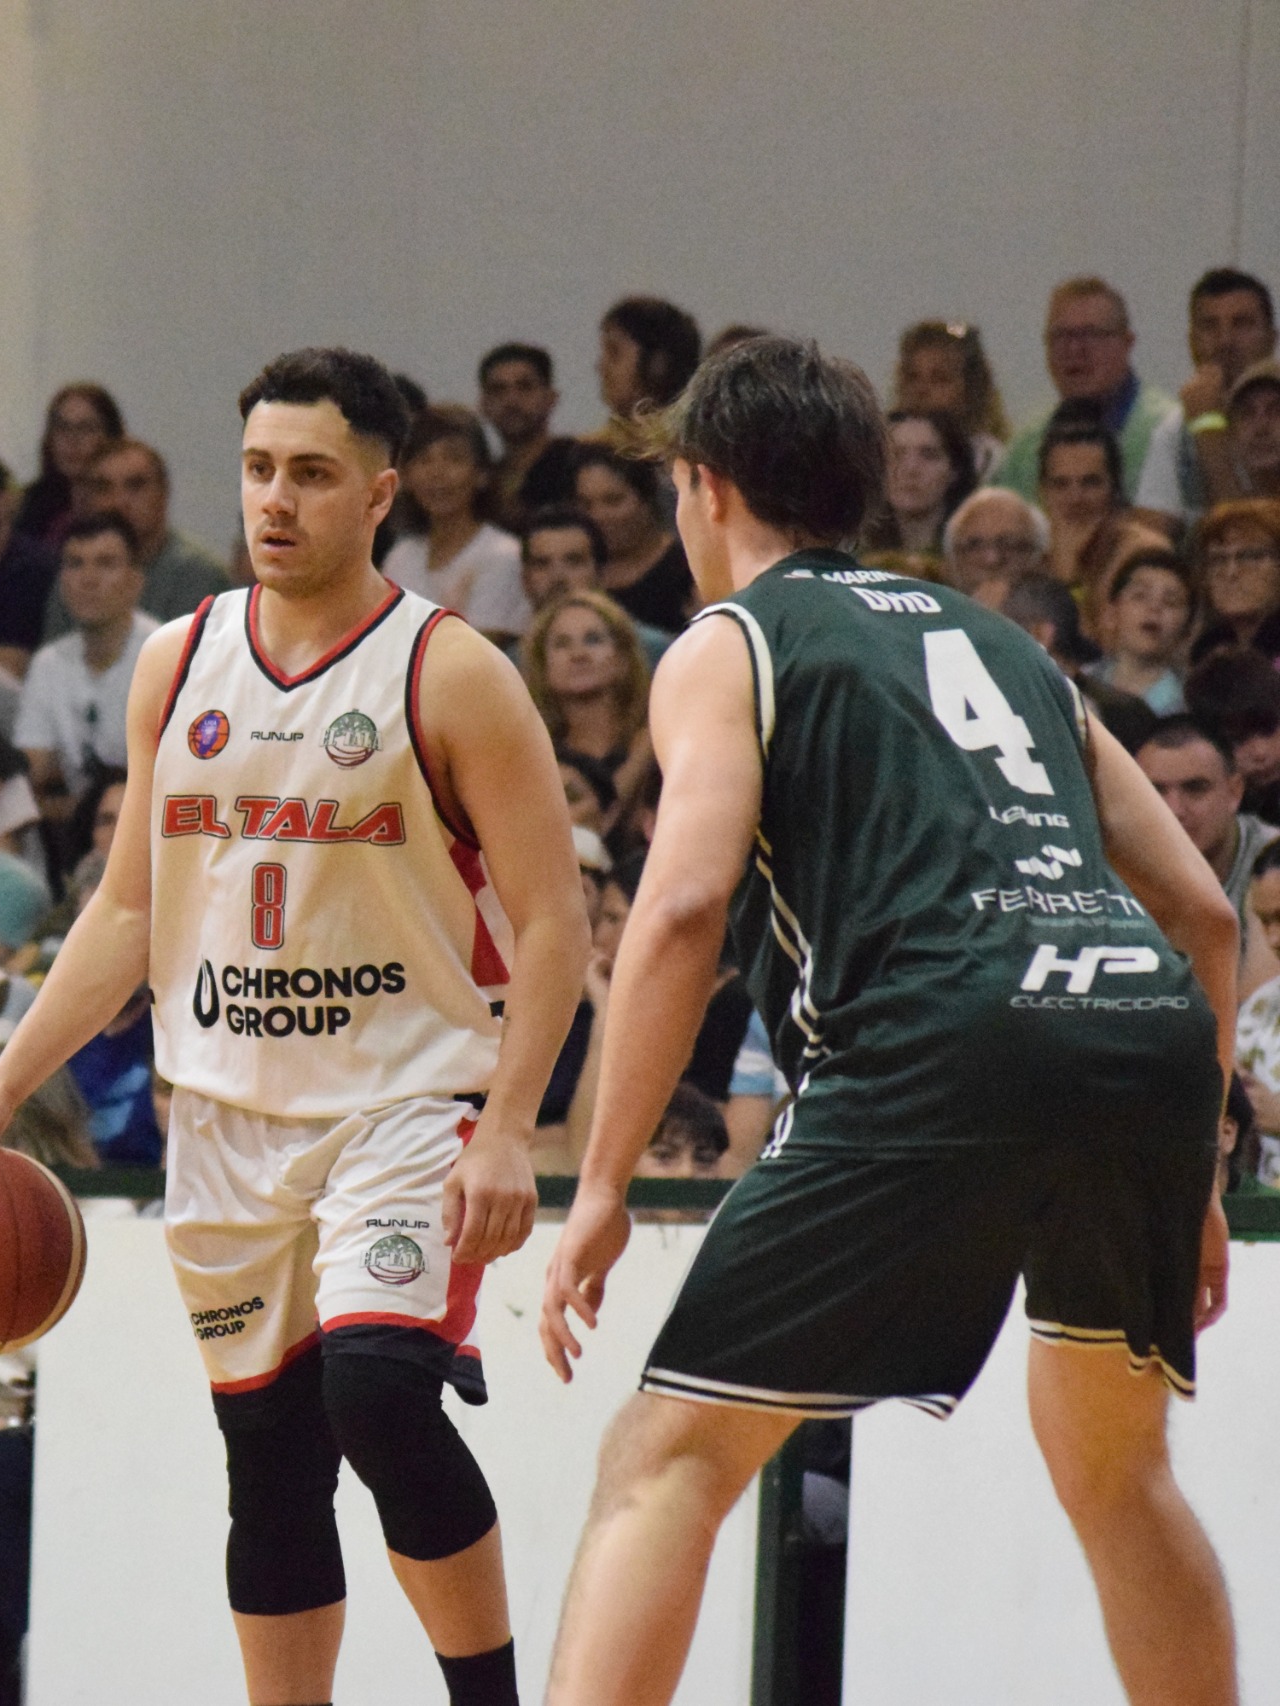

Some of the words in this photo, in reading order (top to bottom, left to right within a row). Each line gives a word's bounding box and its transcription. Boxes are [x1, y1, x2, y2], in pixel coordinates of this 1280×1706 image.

[923, 628, 1055, 796] 4
[250, 730, 305, 742] RUNUP
[162, 795, 231, 838] EL
[235, 795, 406, 846] TALA
[251, 862, 288, 950] 8
[221, 961, 406, 999] CHRONOS
[1020, 944, 1160, 994] HP
[225, 1003, 352, 1038] GROUP
[1010, 995, 1190, 1011] ELECTRICIDAD
[366, 1218, 430, 1229] RUNUP
[190, 1296, 264, 1326] CHRONOS
[196, 1320, 246, 1341] GROUP
